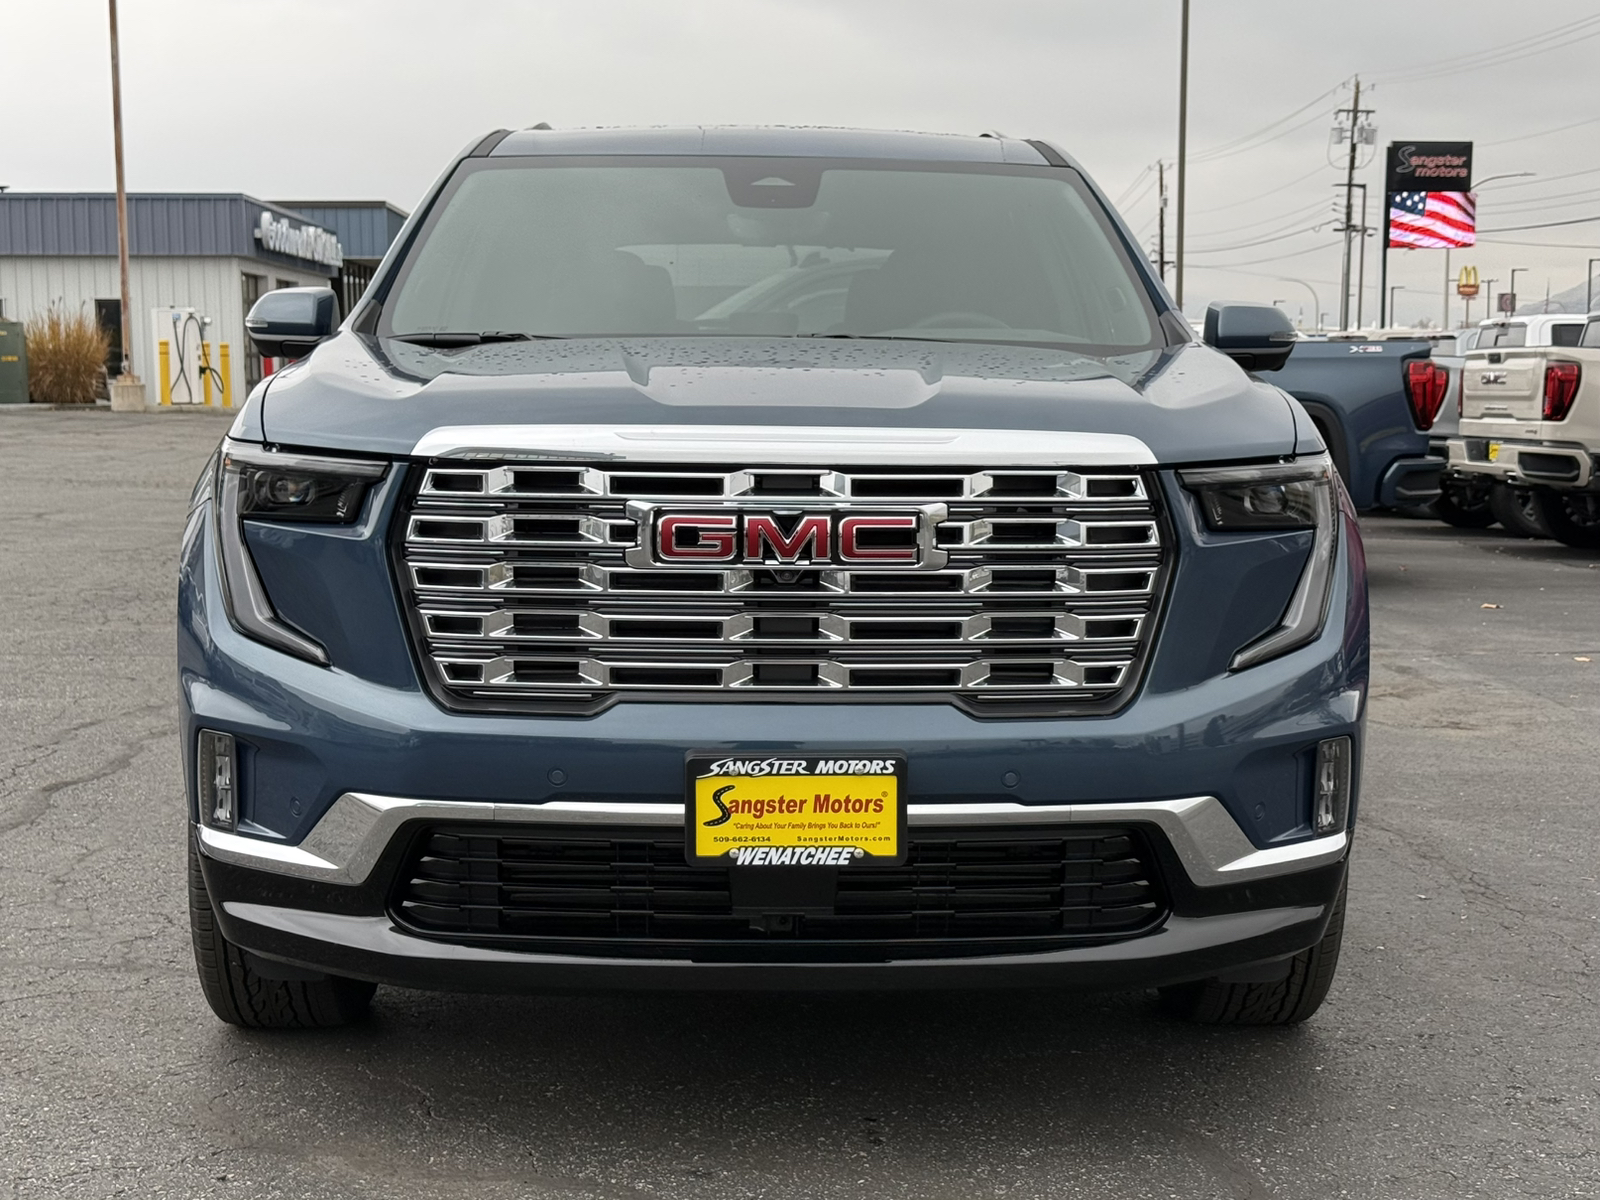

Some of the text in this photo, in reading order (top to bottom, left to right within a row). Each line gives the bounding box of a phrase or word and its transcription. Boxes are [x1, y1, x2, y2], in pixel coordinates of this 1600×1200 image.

[1396, 145, 1467, 173] Sangster
[1415, 166, 1468, 177] motors
[656, 514, 918, 562] GMC
[696, 757, 896, 779] SANGSTER MOTORS
[703, 785, 808, 827] Sangster
[755, 822, 772, 830] About
[773, 822, 787, 830] Your
[788, 822, 807, 831] Family
[807, 821, 826, 831] Brings
[828, 821, 838, 829] You
[839, 821, 854, 829] Back
[854, 821, 861, 829] to
[797, 835, 891, 843] SangsterMotors.com
[736, 847, 856, 865] WENATCHEE
